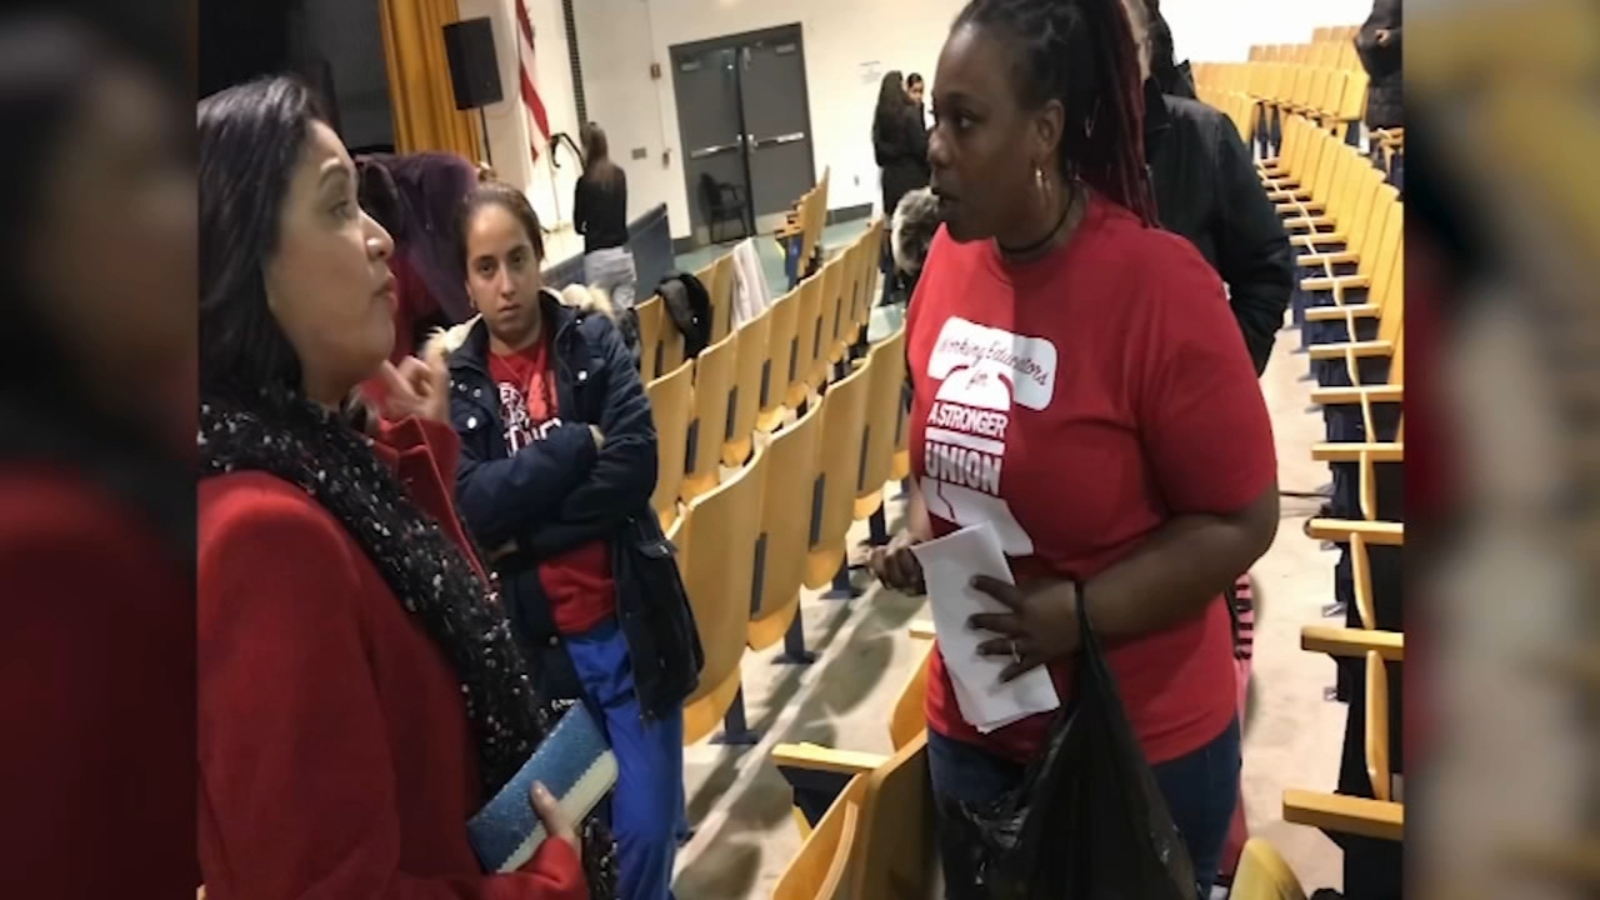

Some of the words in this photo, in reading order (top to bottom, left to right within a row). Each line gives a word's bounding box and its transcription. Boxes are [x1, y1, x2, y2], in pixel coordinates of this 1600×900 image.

[965, 370, 989, 391] for
[985, 340, 1049, 386] Educators
[937, 404, 1009, 438] STRONGER
[925, 441, 1003, 495] UNION
